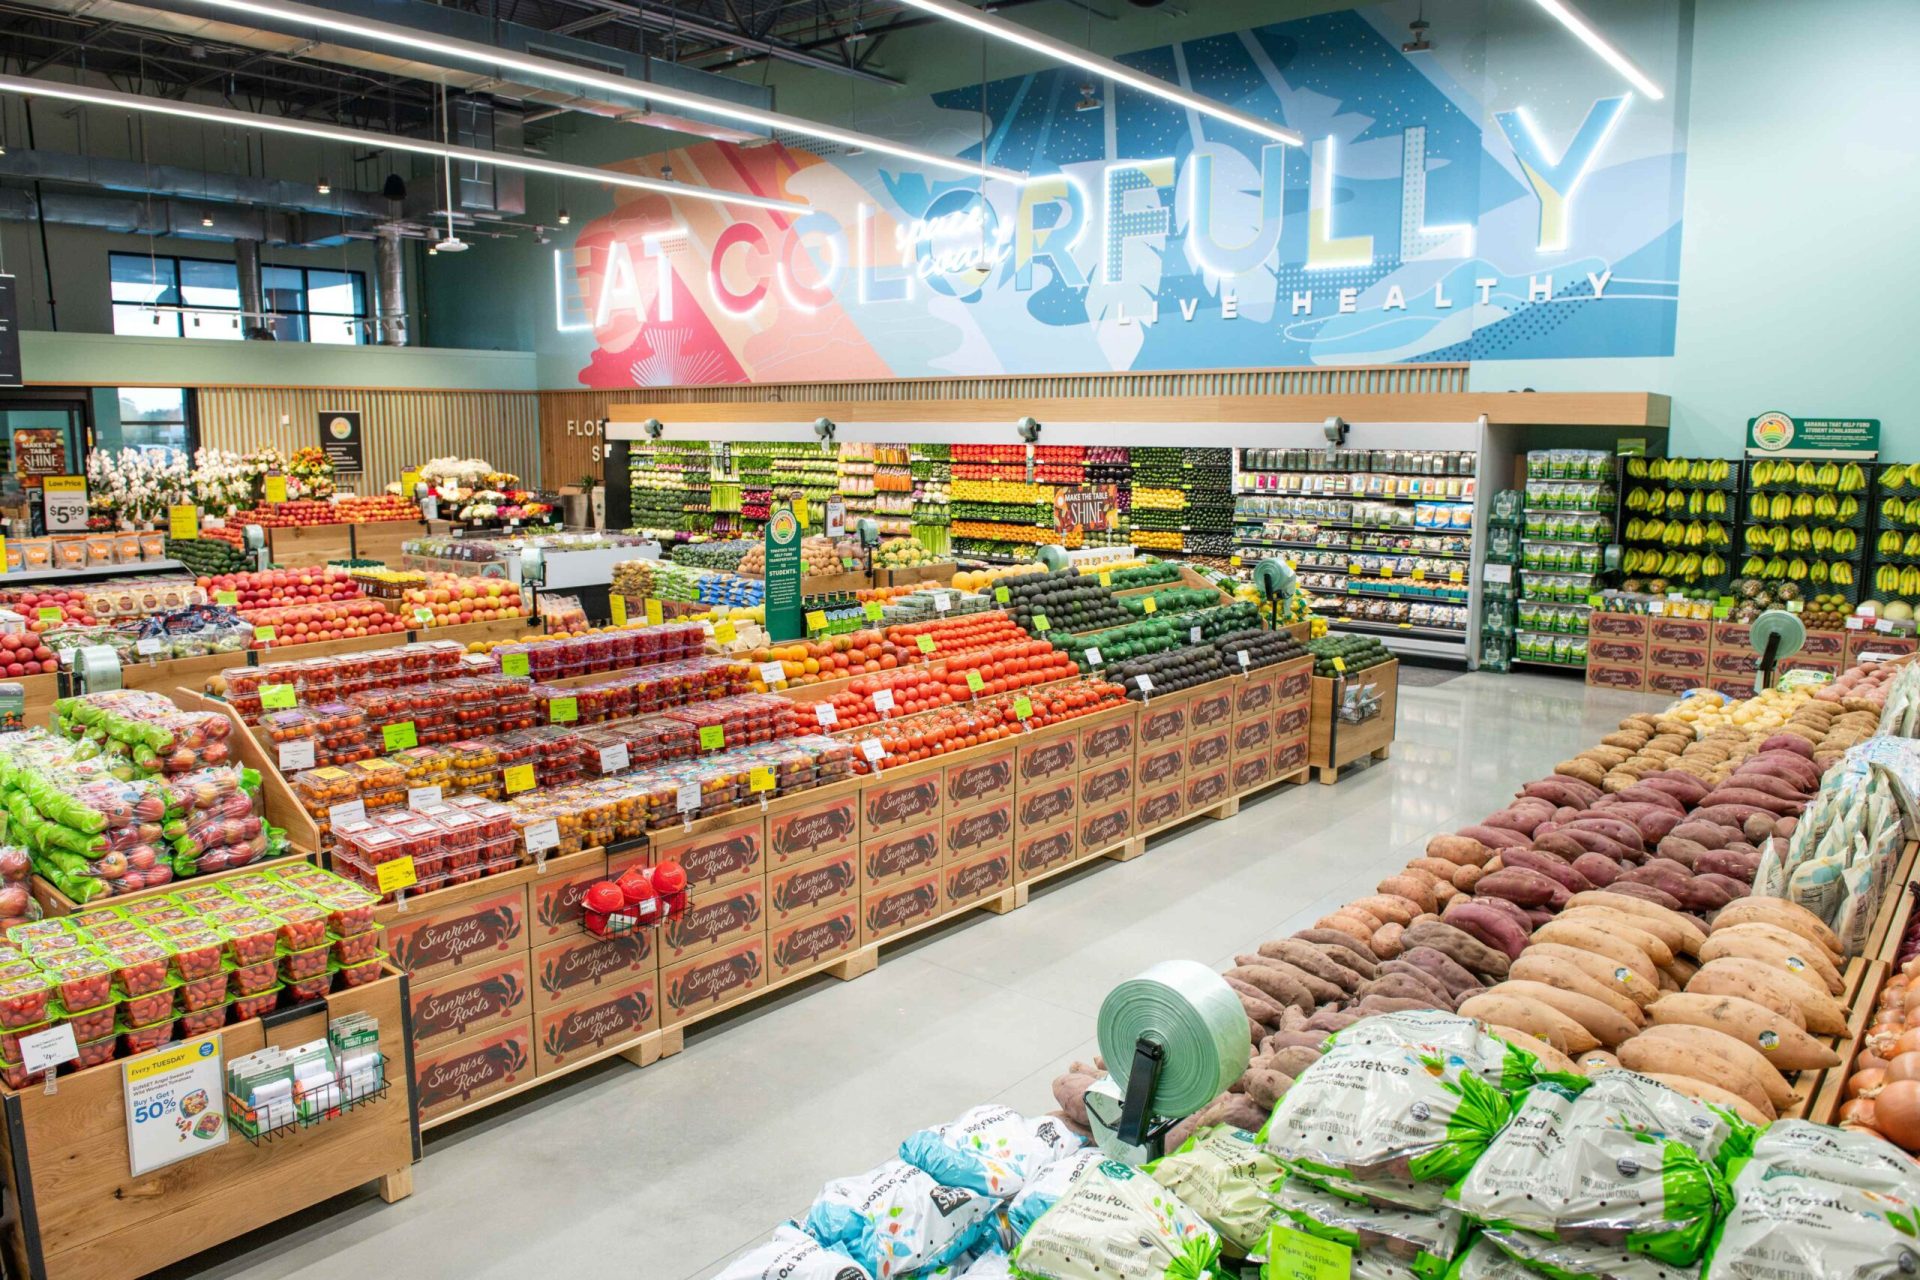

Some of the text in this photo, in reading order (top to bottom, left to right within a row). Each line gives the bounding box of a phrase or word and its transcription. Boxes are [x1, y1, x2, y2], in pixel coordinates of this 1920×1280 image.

[554, 229, 689, 332] EAT
[1118, 271, 1613, 326] LIVE HEALTHY
[64, 480, 82, 488] Price
[1064, 491, 1108, 502] MAKE THE TABLE
[1070, 501, 1104, 526] SHINE
[768, 568, 798, 577] STUDENTS.
[1032, 749, 1058, 765] Sunrise
[1041, 756, 1062, 773] Roots
[961, 768, 992, 787] Sunrise
[971, 777, 996, 795] Roots
[882, 789, 916, 810] Sunrise
[892, 799, 920, 818] Roots
[1031, 794, 1057, 811] Sunrise
[1040, 802, 1061, 818] Roots
[791, 815, 829, 838] Sunrise
[802, 825, 834, 846] Roots
[961, 817, 991, 836] Sunrise
[970, 826, 995, 844] Roots
[685, 844, 728, 870] Sunrise
[882, 842, 915, 863] Sunrise
[1030, 839, 1056, 857] Sunrise
[1038, 847, 1060, 864] Roots
[700, 854, 735, 879] Roots
[891, 851, 920, 871] Roots
[791, 870, 829, 894] Sunrise
[960, 865, 990, 885] Sunrise
[969, 873, 994, 892] Roots
[802, 881, 834, 902] Roots
[882, 892, 915, 914] Sunrise
[891, 902, 920, 921] Roots
[686, 903, 730, 930] Sunrise
[701, 915, 736, 939] Roots
[420, 919, 479, 950] Sunrise
[437, 929, 487, 959] Roots
[791, 924, 830, 950] Sunrise
[565, 940, 616, 972] Sunrise
[803, 935, 835, 957] Roots
[579, 951, 623, 980] Roots
[688, 962, 732, 990] Sunrise
[702, 973, 737, 998] Roots
[423, 987, 482, 1020] Sunrise
[440, 997, 490, 1029] Roots
[568, 1003, 617, 1034] Sunrise
[584, 1014, 625, 1043] Roots
[131, 1054, 186, 1076] Every TUESDAY
[428, 1054, 486, 1088] Sunrise
[133, 1082, 154, 1091] SUNSET
[154, 1076, 169, 1086] Angel
[133, 1089, 146, 1097] Wild
[146, 1083, 168, 1094] Wonders
[446, 1063, 494, 1096] Roots
[133, 1098, 148, 1108] Buy
[155, 1091, 171, 1101] Get
[135, 1096, 177, 1124] 50%
[164, 1107, 176, 1115] OFF
[1514, 1117, 1547, 1129] Red
